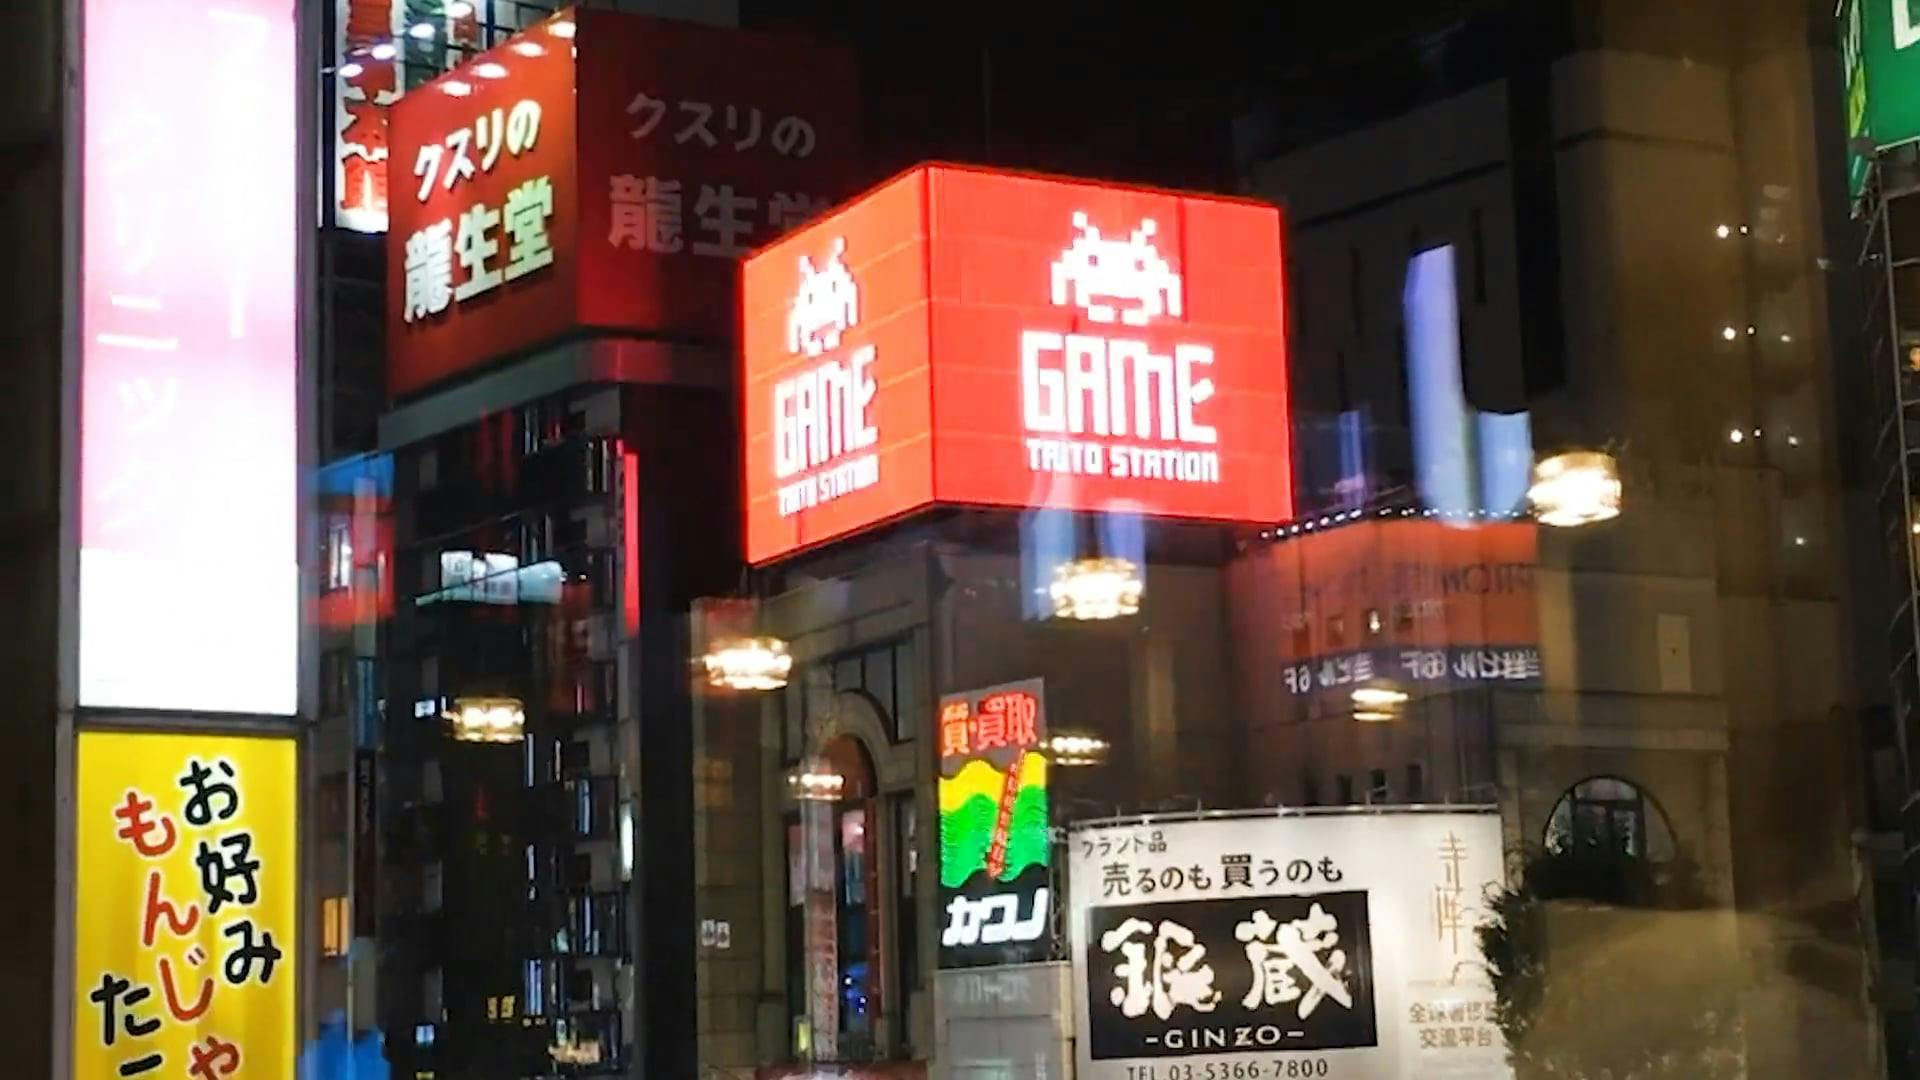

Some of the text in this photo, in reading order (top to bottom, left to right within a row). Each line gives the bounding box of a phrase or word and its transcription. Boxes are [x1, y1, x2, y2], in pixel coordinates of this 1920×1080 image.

[414, 99, 541, 201] クスリの
[625, 93, 817, 158] クスリの
[405, 175, 553, 322] 龍生堂
[775, 344, 879, 478] GAME
[1022, 330, 1217, 444] GAME
[1026, 437, 1219, 482] TAITO STATION
[180, 761, 281, 984] お好み
[942, 887, 1049, 946] カワノ
[1169, 1058, 1329, 1080] 03-5366-7800
